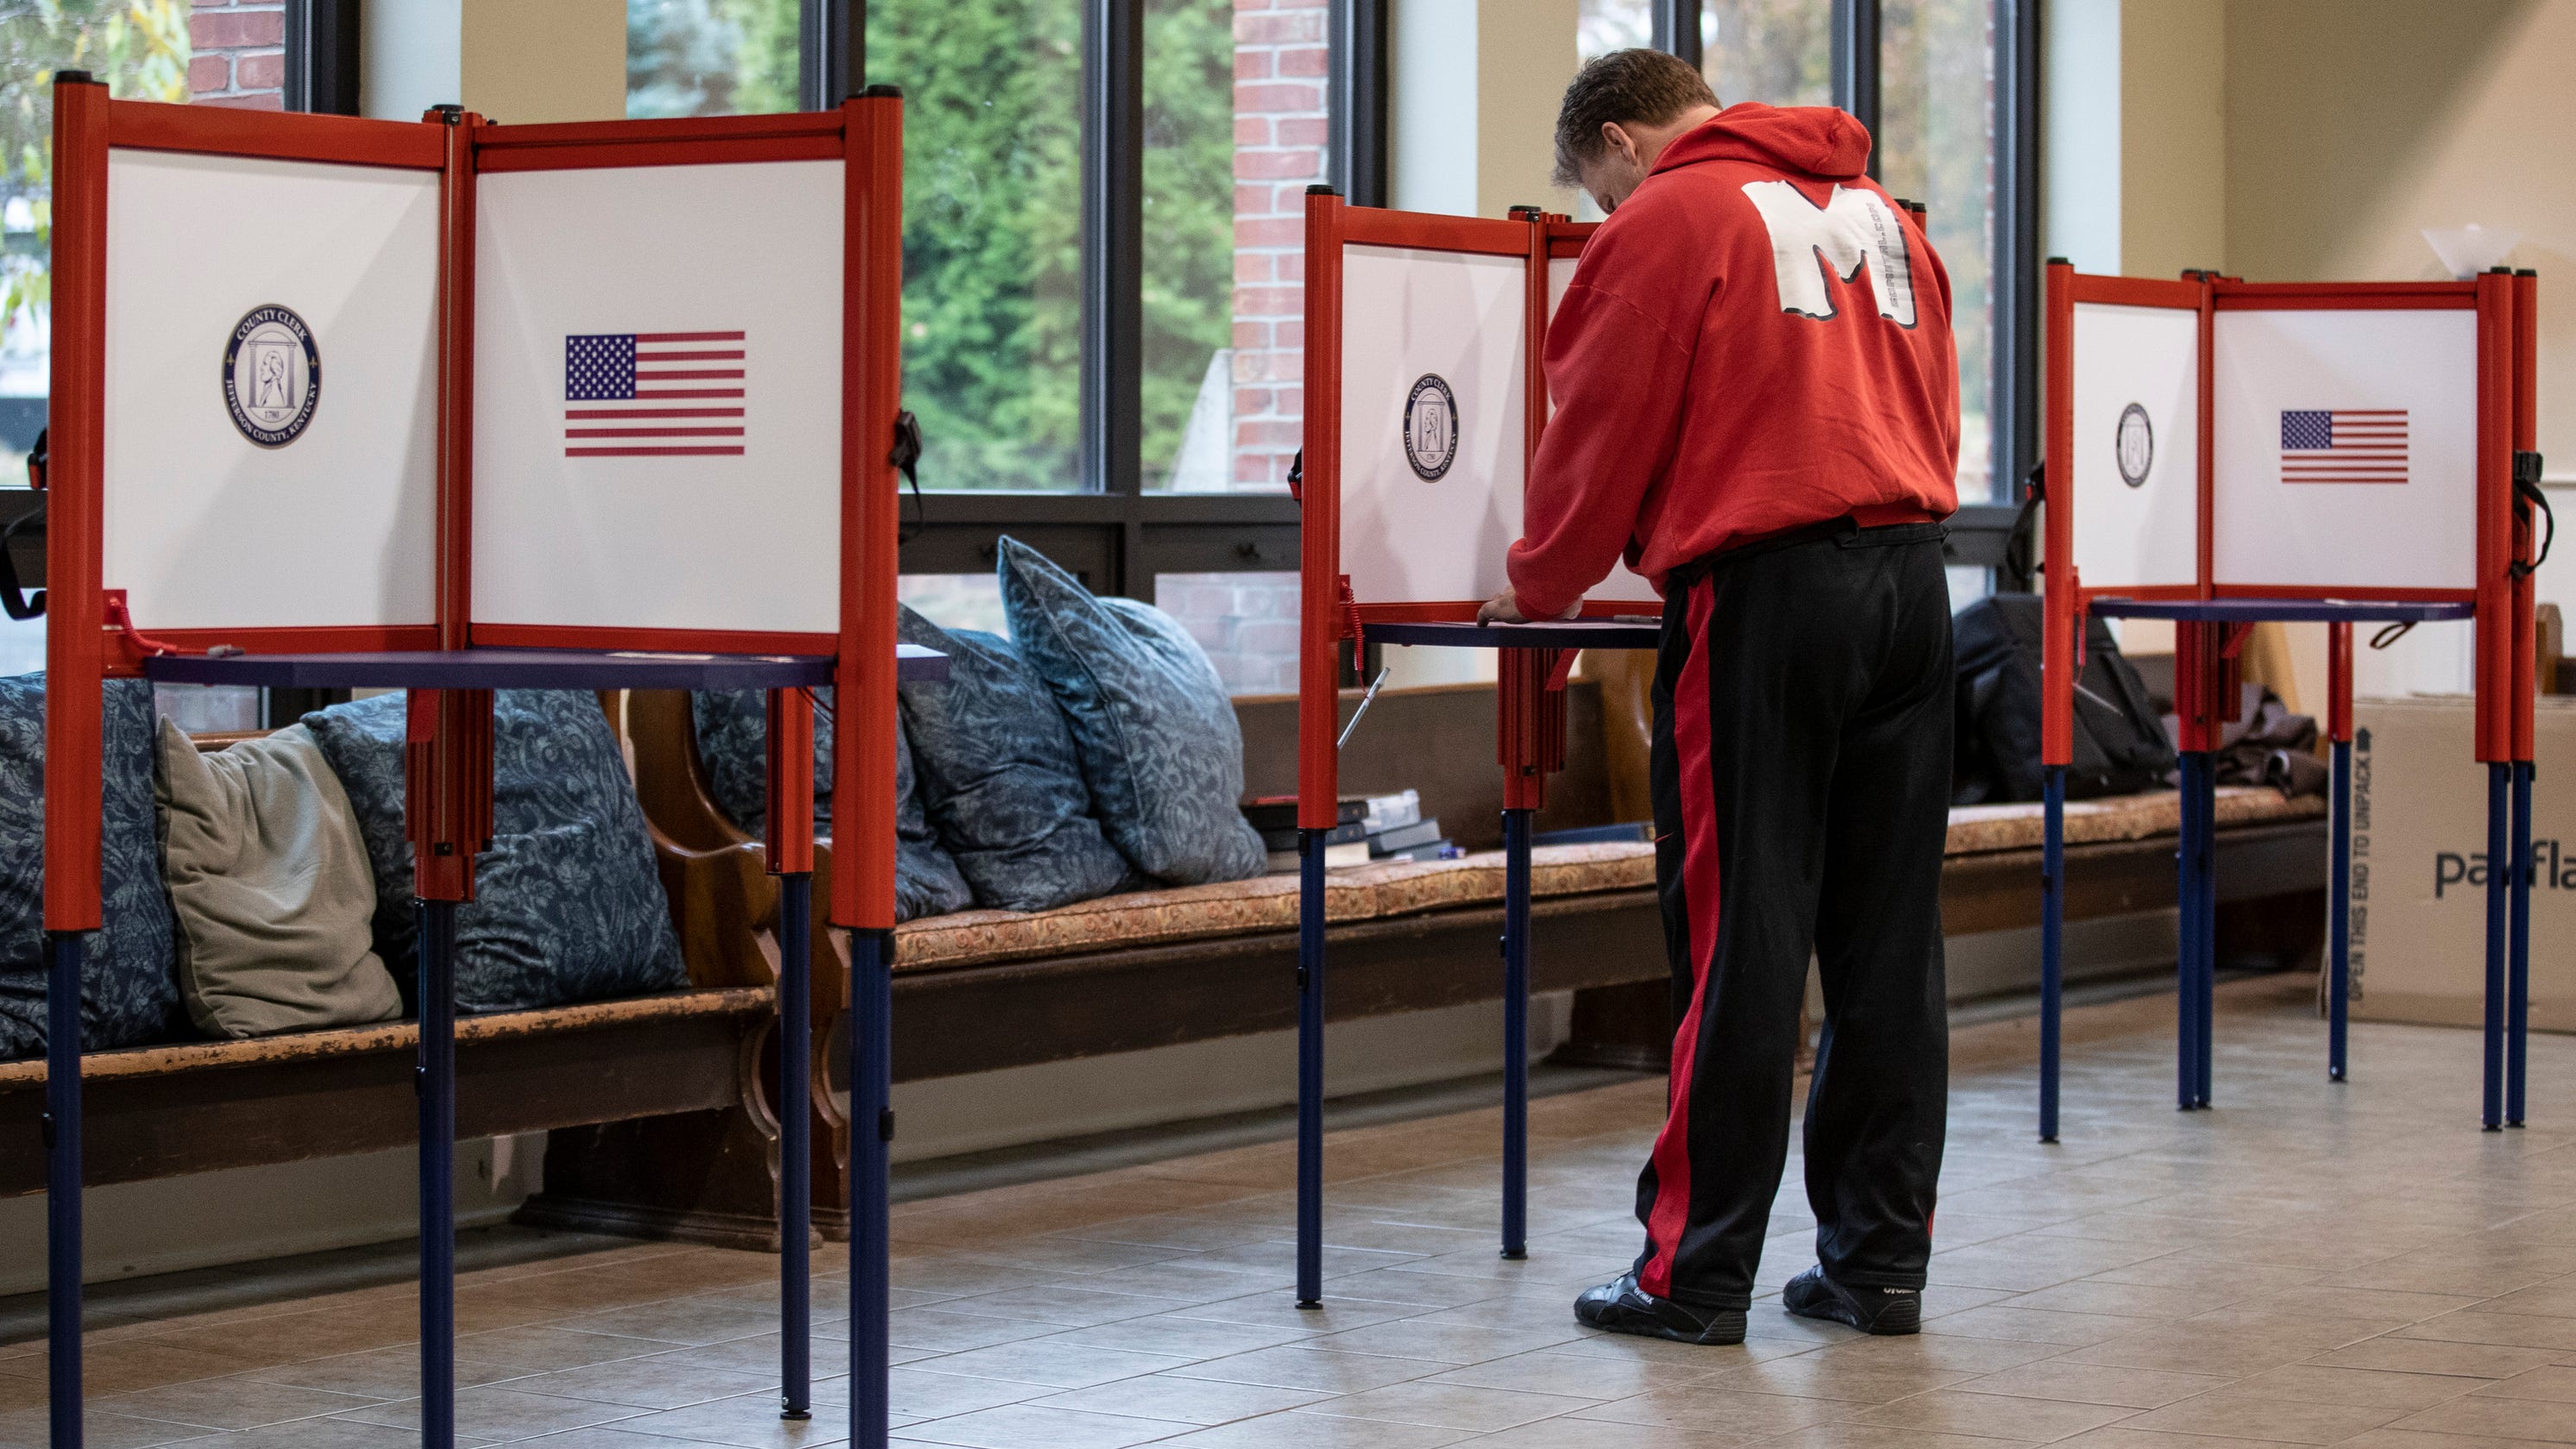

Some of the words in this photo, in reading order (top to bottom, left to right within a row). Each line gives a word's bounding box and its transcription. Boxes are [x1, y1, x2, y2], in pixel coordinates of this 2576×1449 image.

[1741, 179, 1918, 329] M
[236, 309, 275, 341] COUNTY
[277, 310, 307, 342] CLERK
[225, 380, 254, 433] JEFFERSON
[288, 383, 317, 435] KENTUCKY
[1411, 378, 1433, 401] COUNTY
[1434, 379, 1451, 400] CLERK
[2354, 756, 2371, 831] UNPACK
[2353, 834, 2370, 856] TO
[2352, 863, 2370, 900] END
[2350, 906, 2368, 945] THIS
[2348, 952, 2365, 1001] OPEN
